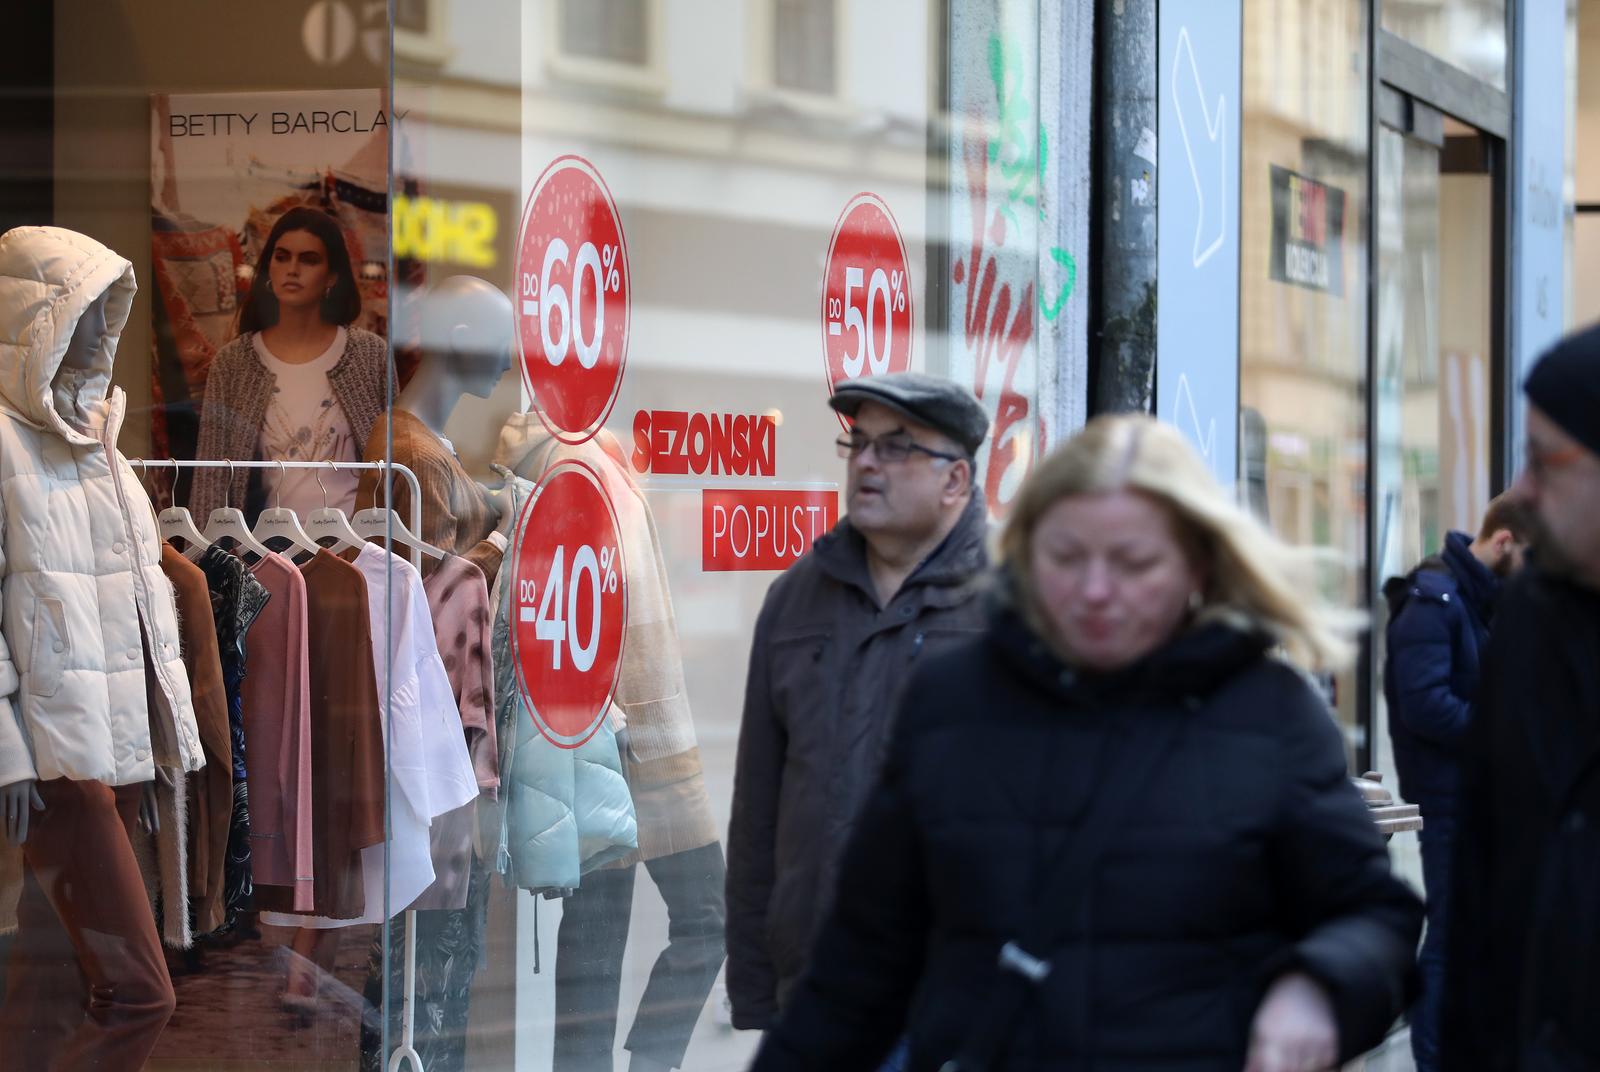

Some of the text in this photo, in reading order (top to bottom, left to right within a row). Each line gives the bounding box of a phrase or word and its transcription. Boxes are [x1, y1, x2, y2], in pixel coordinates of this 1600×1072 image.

[170, 113, 258, 137] BETTY
[523, 272, 539, 297] DO
[829, 297, 842, 319] DO
[631, 409, 776, 476] SEZONSKI
[520, 579, 536, 604] DO
